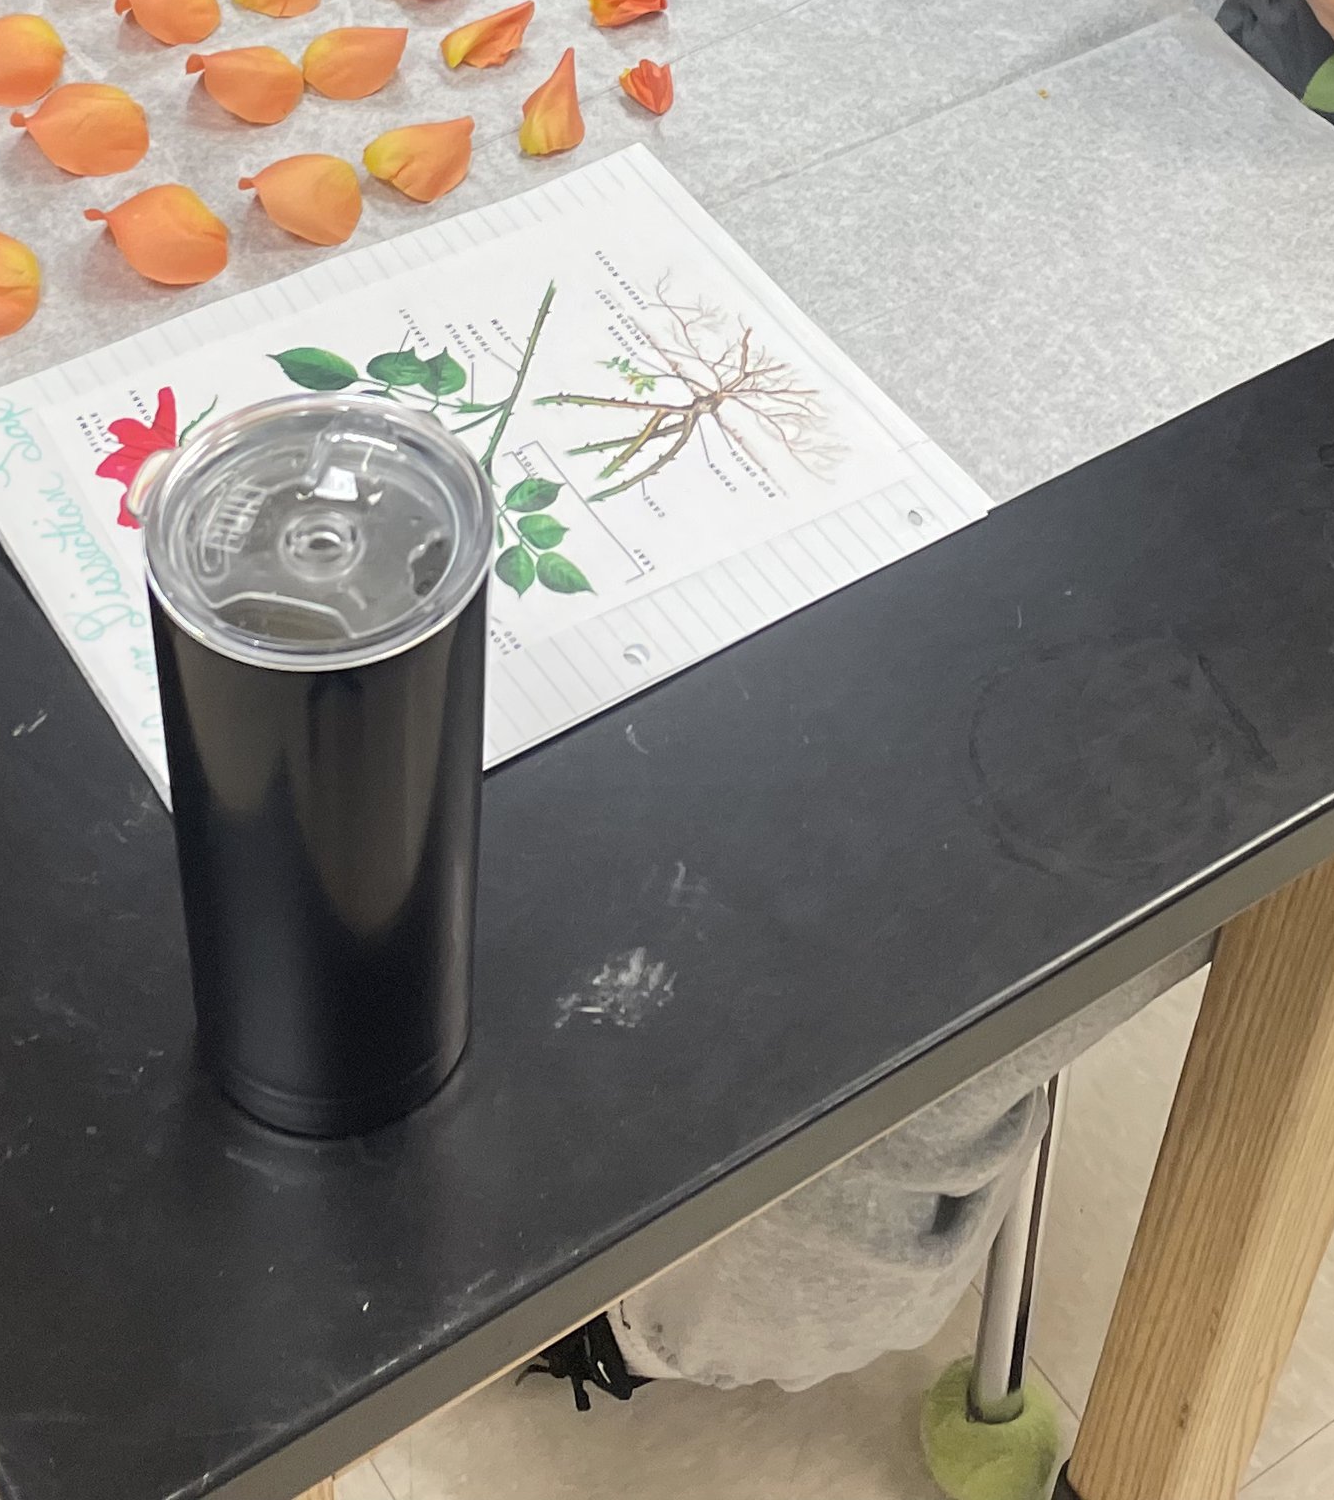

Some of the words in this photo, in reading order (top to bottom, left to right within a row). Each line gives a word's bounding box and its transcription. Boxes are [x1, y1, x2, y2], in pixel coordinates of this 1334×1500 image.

[594, 250, 619, 278] ROOTS
[594, 288, 615, 311] ROOT
[619, 280, 648, 311] FEEDER
[399, 308, 430, 348] LEAFLET
[445, 323, 476, 360] STIPULE
[467, 323, 491, 352] THORN
[490, 318, 511, 342] STEM
[607, 325, 637, 357] SUCKER
[616, 313, 646, 347] ANCHOR
[128, 389, 152, 421] OVARY
[76, 415, 102, 453] STIGMA
[89, 412, 112, 443] STYLE
[709, 463, 737, 493] CROWN
[730, 450, 757, 478] UNION
[643, 495, 666, 518] CANE
[33, 471, 147, 641] Dissection
[633, 548, 655, 572] LEAF
